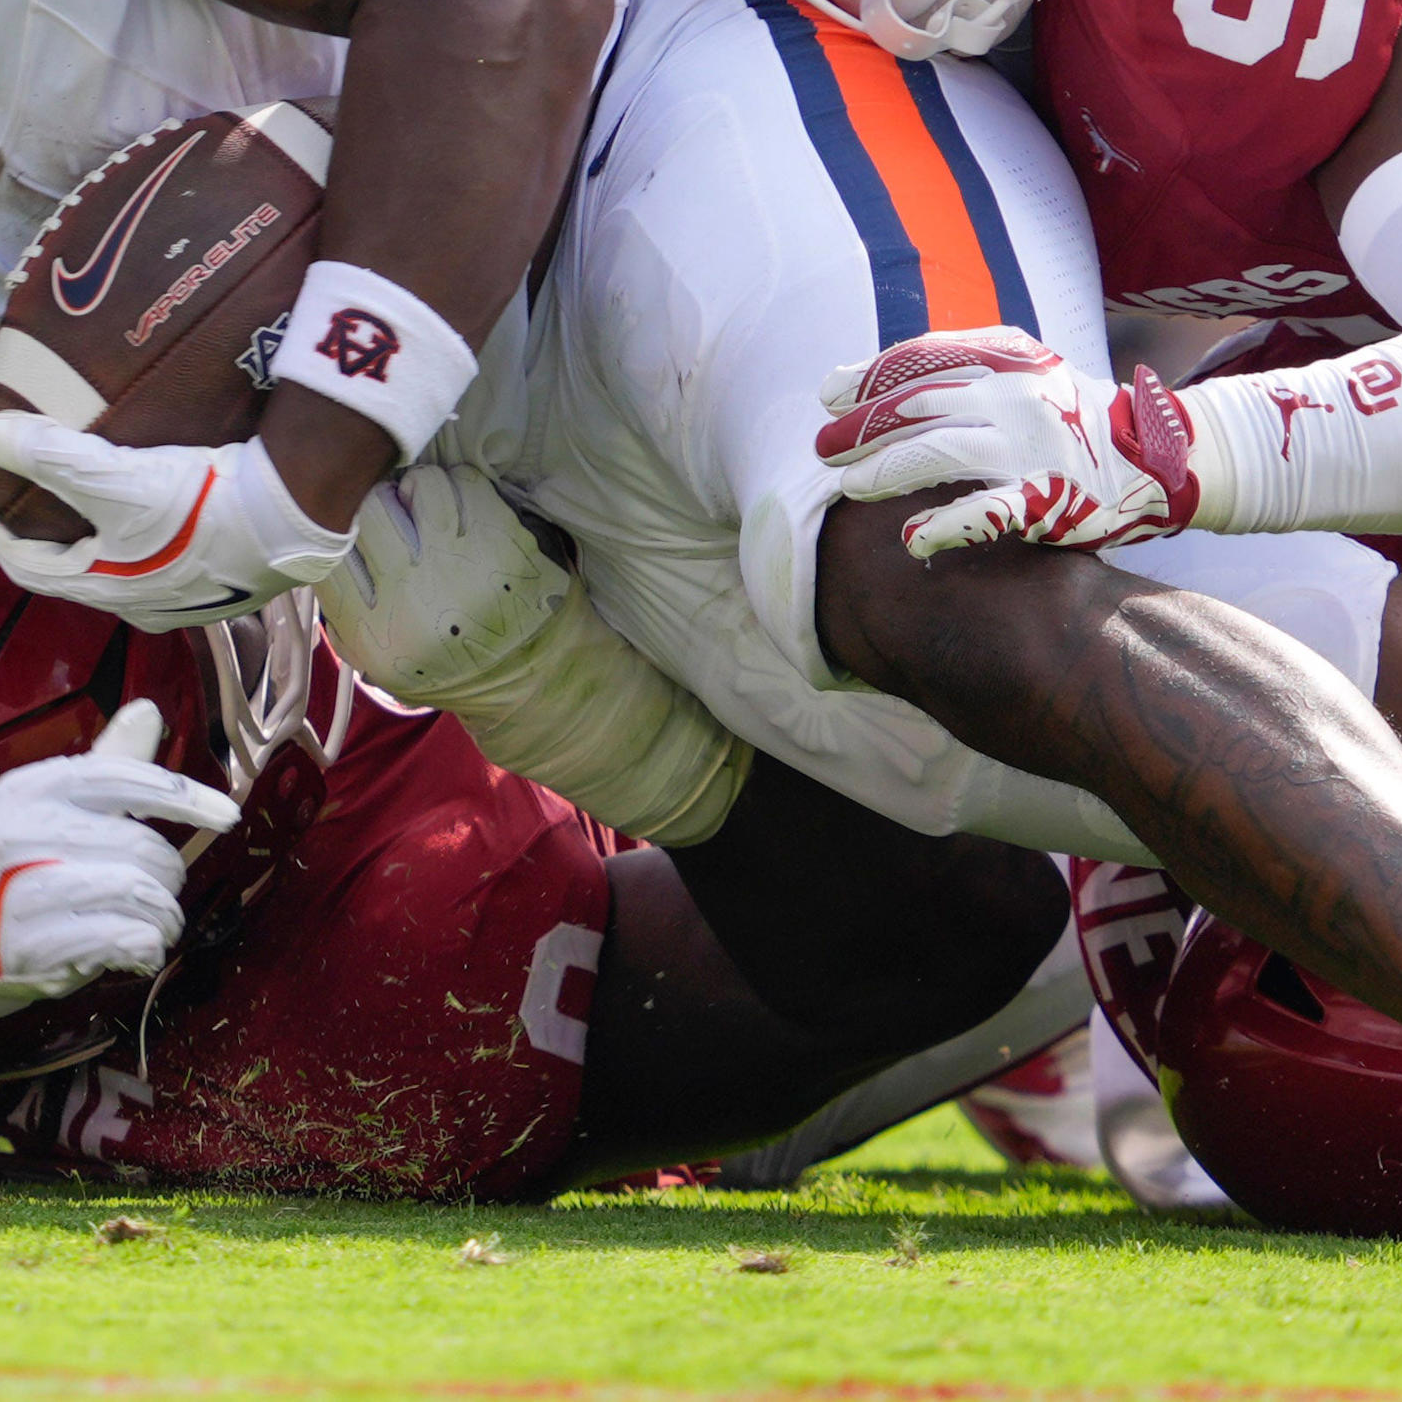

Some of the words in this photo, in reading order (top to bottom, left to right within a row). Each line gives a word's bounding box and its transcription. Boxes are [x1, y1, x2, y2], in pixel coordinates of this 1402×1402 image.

[123, 263, 216, 346] VAPOR
[202, 202, 282, 270] ELITE
[1147, 372, 1186, 439] JORDAN
[1348, 360, 1402, 416] OU
